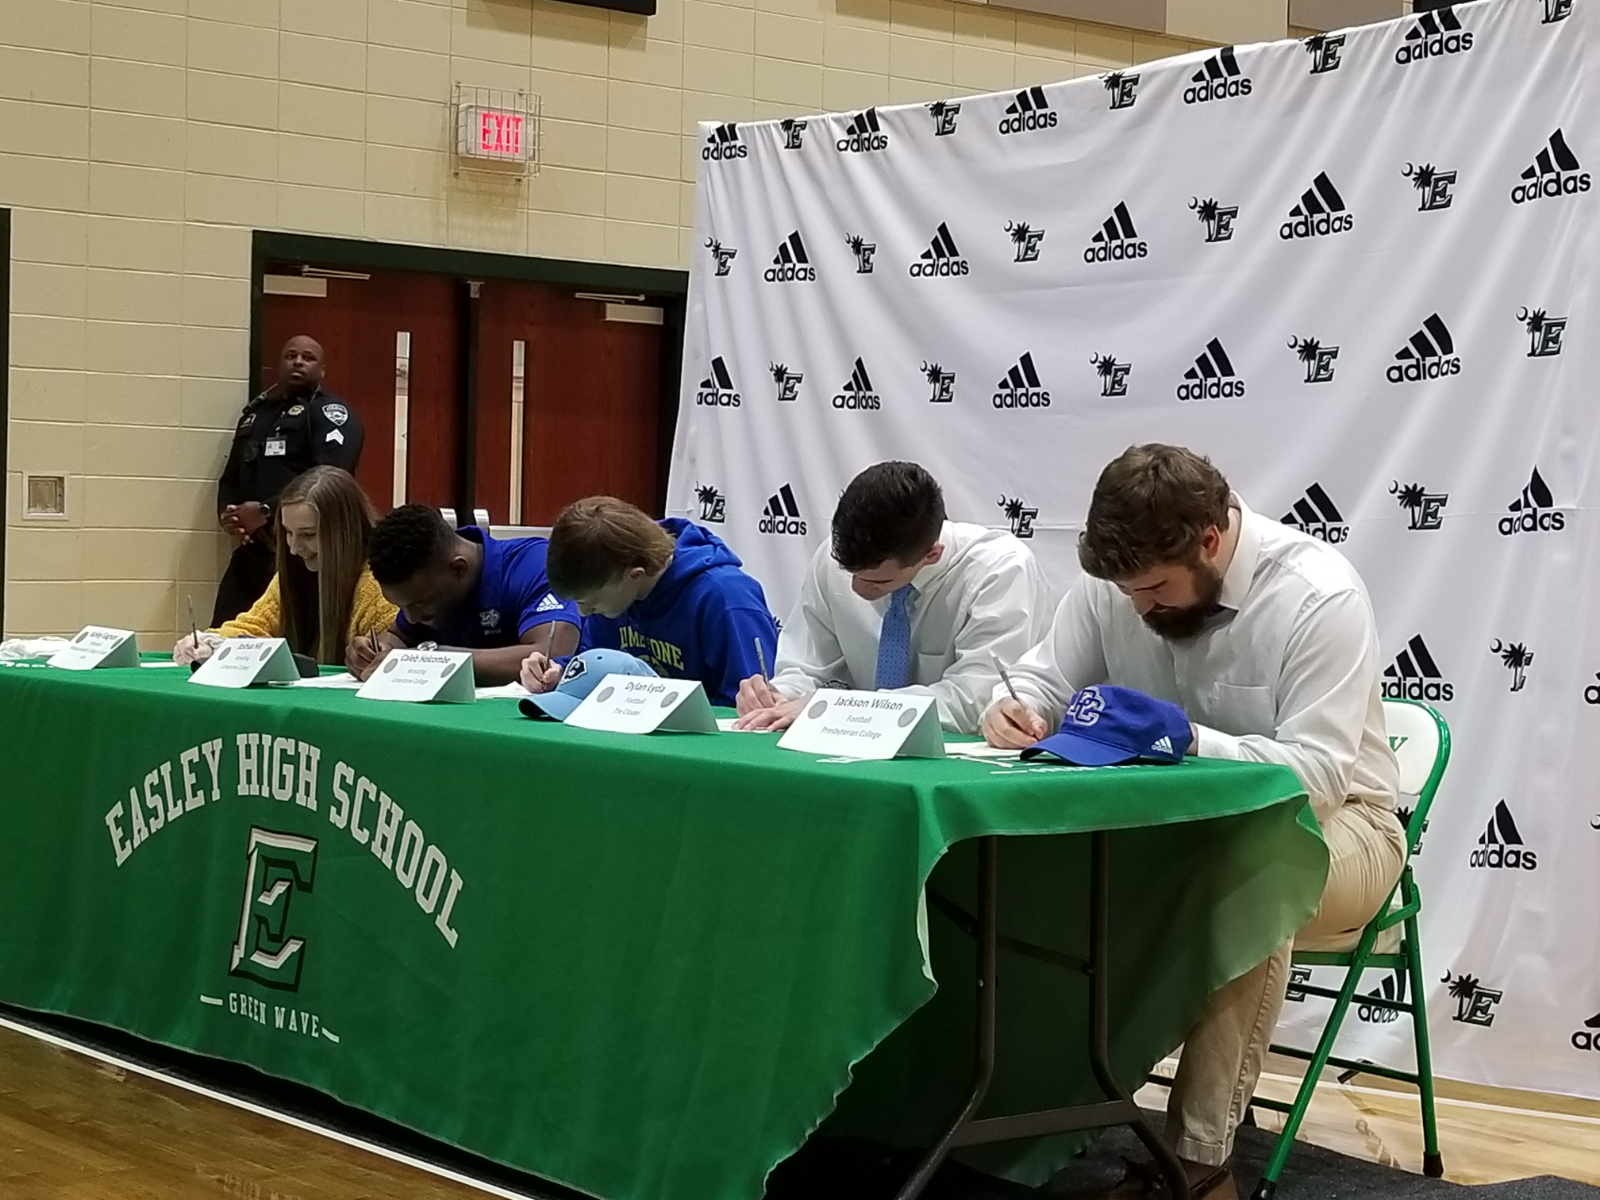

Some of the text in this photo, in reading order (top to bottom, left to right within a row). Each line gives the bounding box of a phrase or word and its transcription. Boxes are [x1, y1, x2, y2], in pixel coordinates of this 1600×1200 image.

[1395, 29, 1473, 65] adidas
[1183, 77, 1252, 104] adidas
[999, 108, 1057, 135] adidas
[482, 113, 522, 154] EXIT
[837, 132, 888, 153] adidas
[1511, 170, 1591, 204] adidas
[1279, 211, 1353, 240] adidas
[1083, 239, 1148, 263] adidas
[909, 257, 969, 277] adidas
[1386, 355, 1460, 383] adidas
[832, 388, 880, 410] adidas
[992, 387, 1050, 409] adidas
[1177, 377, 1245, 400] adidas
[759, 516, 807, 536] adidas
[400, 654, 420, 662] Caleb
[624, 681, 666, 694] Dylan Lyda
[834, 696, 903, 710] Jackson Wilson
[846, 714, 873, 724] Football
[821, 726, 881, 739] Presbyterian College
[105, 733, 463, 949] EASLEY HIGH SCHOOL
[228, 824, 318, 992] E
[229, 993, 320, 1038] GREEN WAVE
